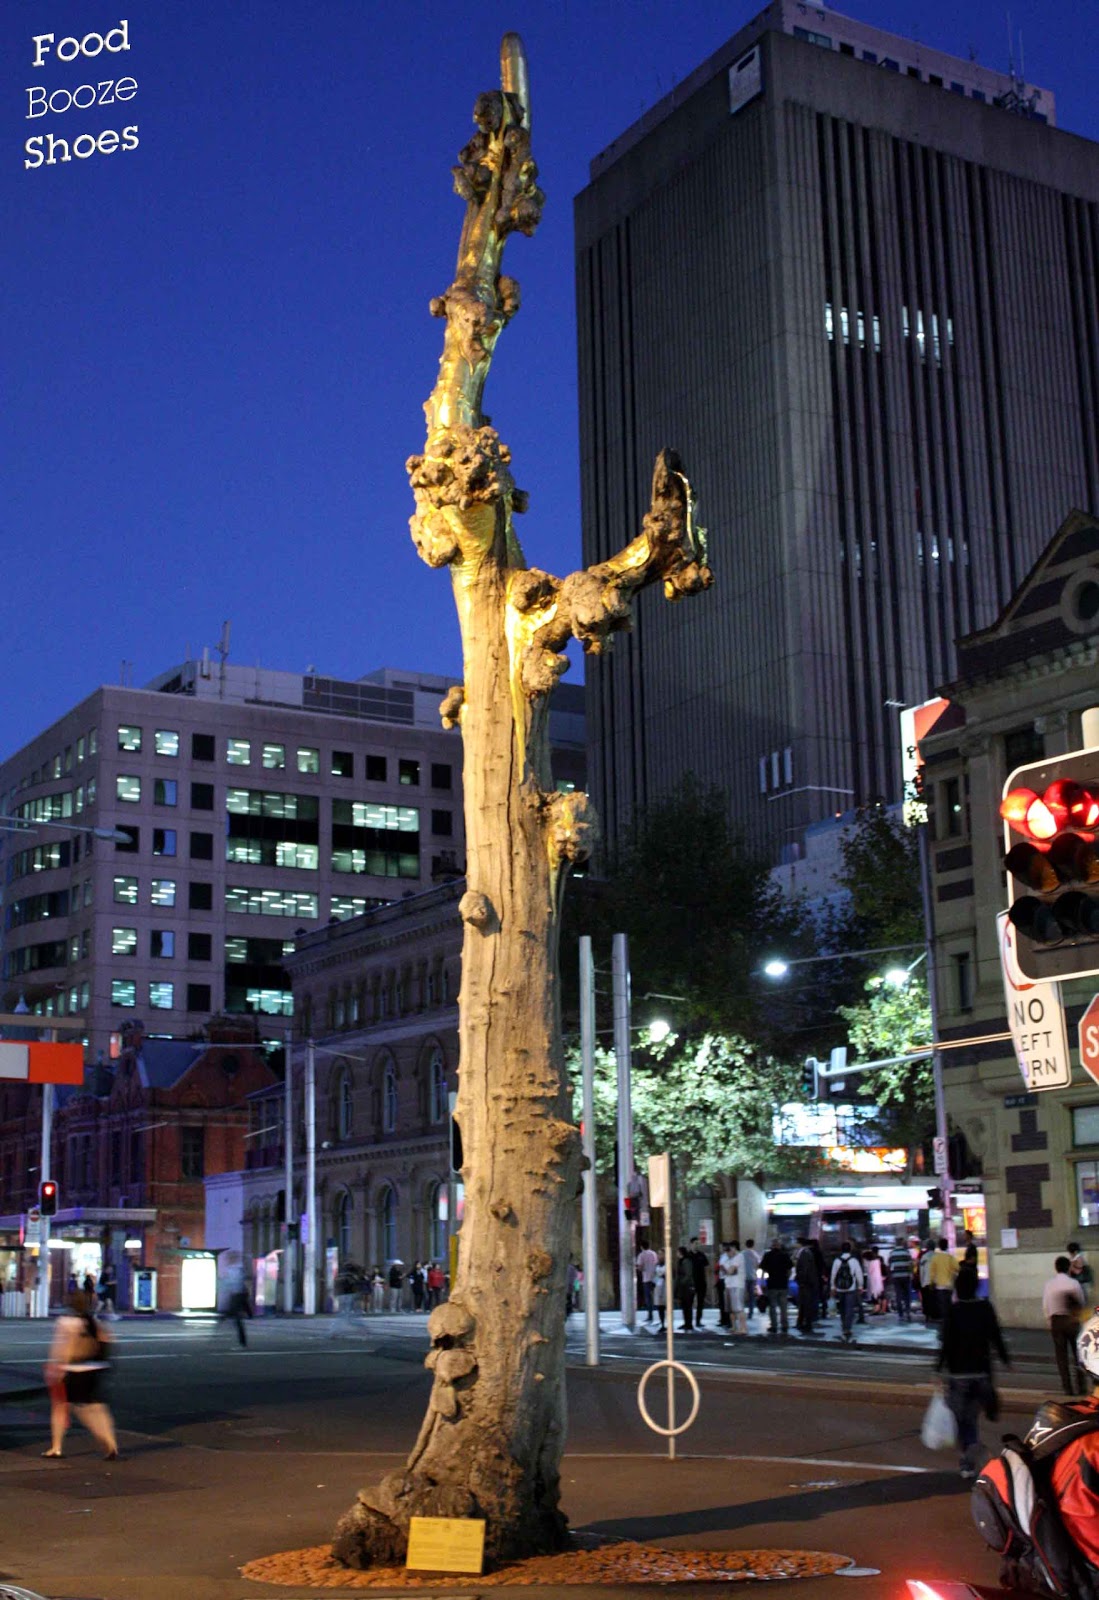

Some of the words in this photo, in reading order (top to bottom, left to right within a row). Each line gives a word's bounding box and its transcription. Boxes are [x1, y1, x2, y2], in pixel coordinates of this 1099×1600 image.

[1014, 998, 1044, 1027] NO
[1017, 1031, 1052, 1052] EFT
[1086, 1025, 1099, 1058] S
[1020, 1057, 1057, 1078] URN
